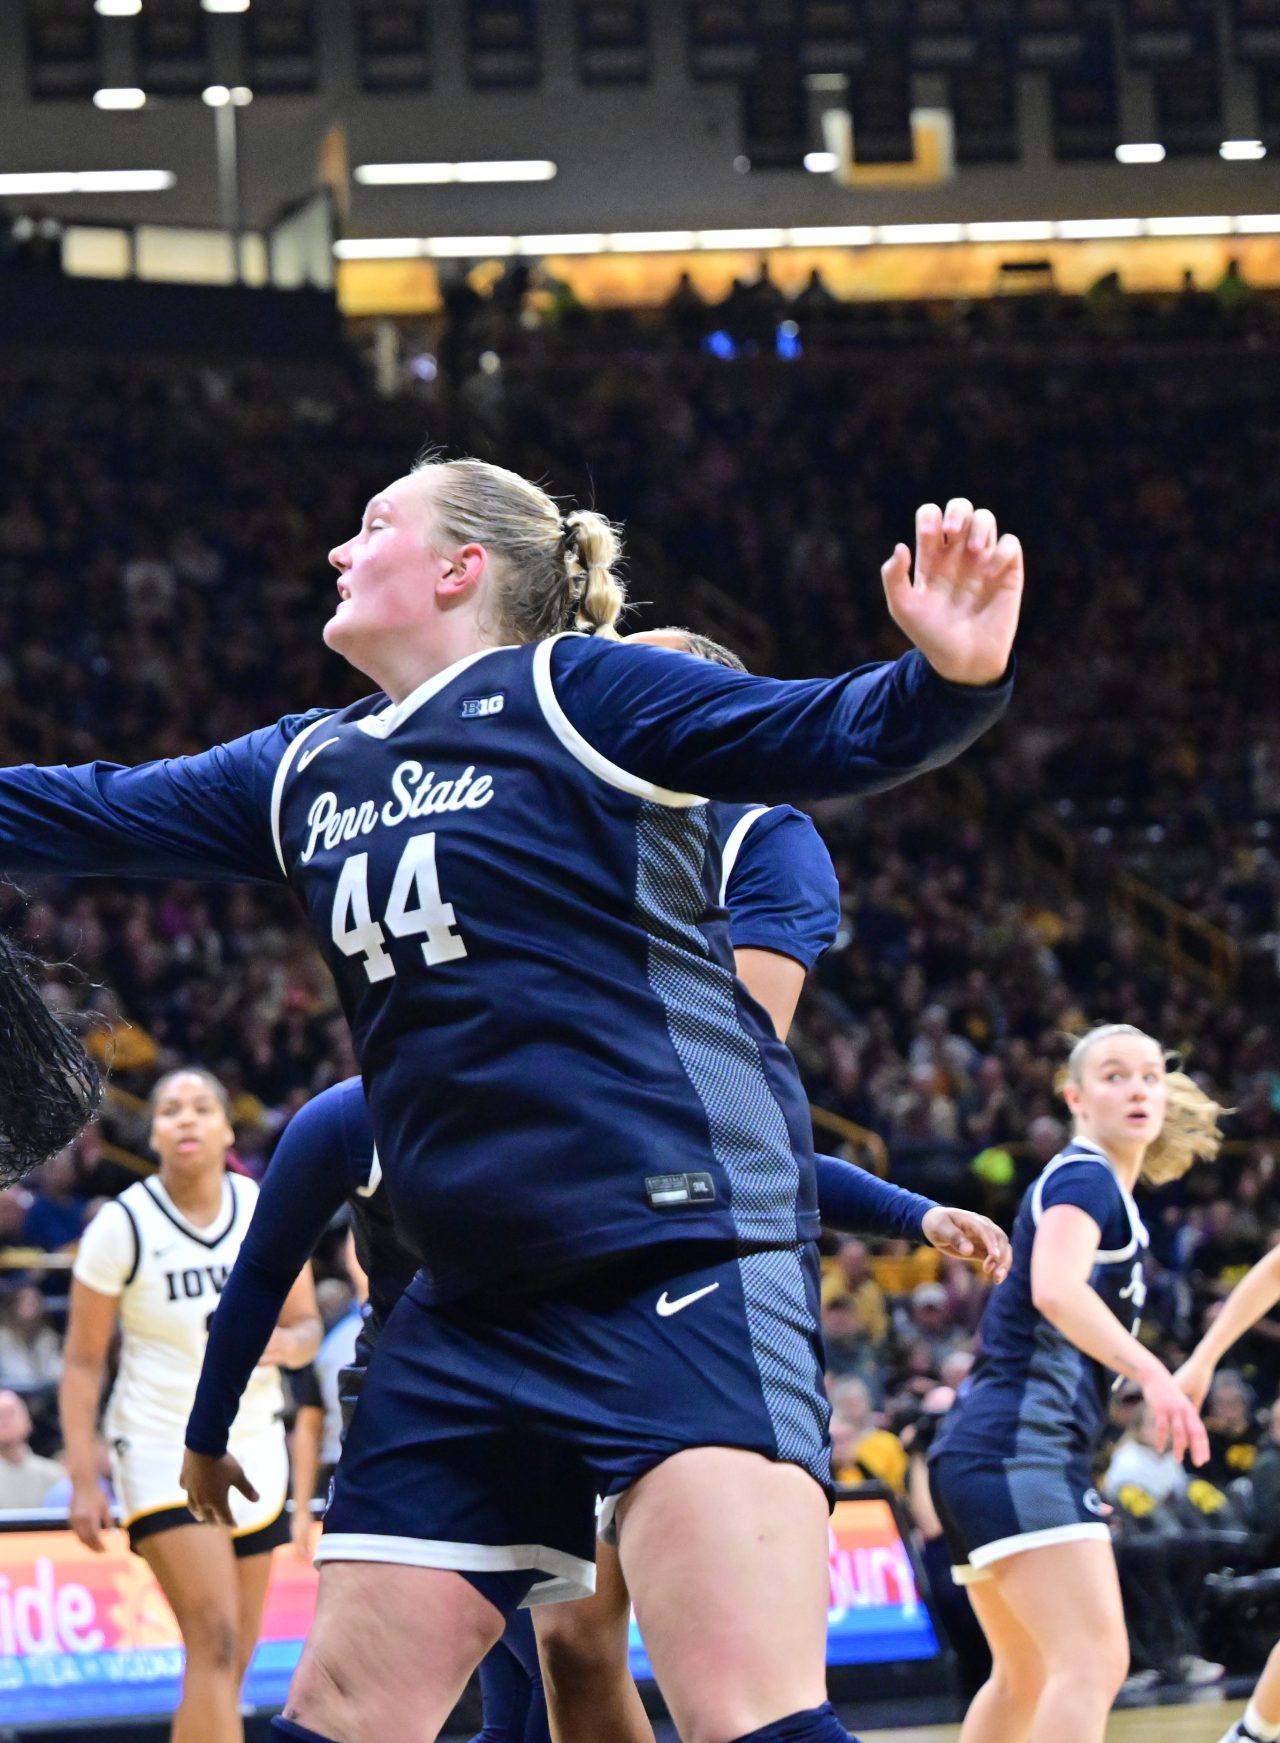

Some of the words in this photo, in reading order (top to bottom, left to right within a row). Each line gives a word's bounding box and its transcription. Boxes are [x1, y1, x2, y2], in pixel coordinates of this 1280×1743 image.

[461, 694, 504, 718] BIG
[301, 791, 379, 863] Penn
[381, 760, 495, 827] State
[331, 832, 468, 984] 44
